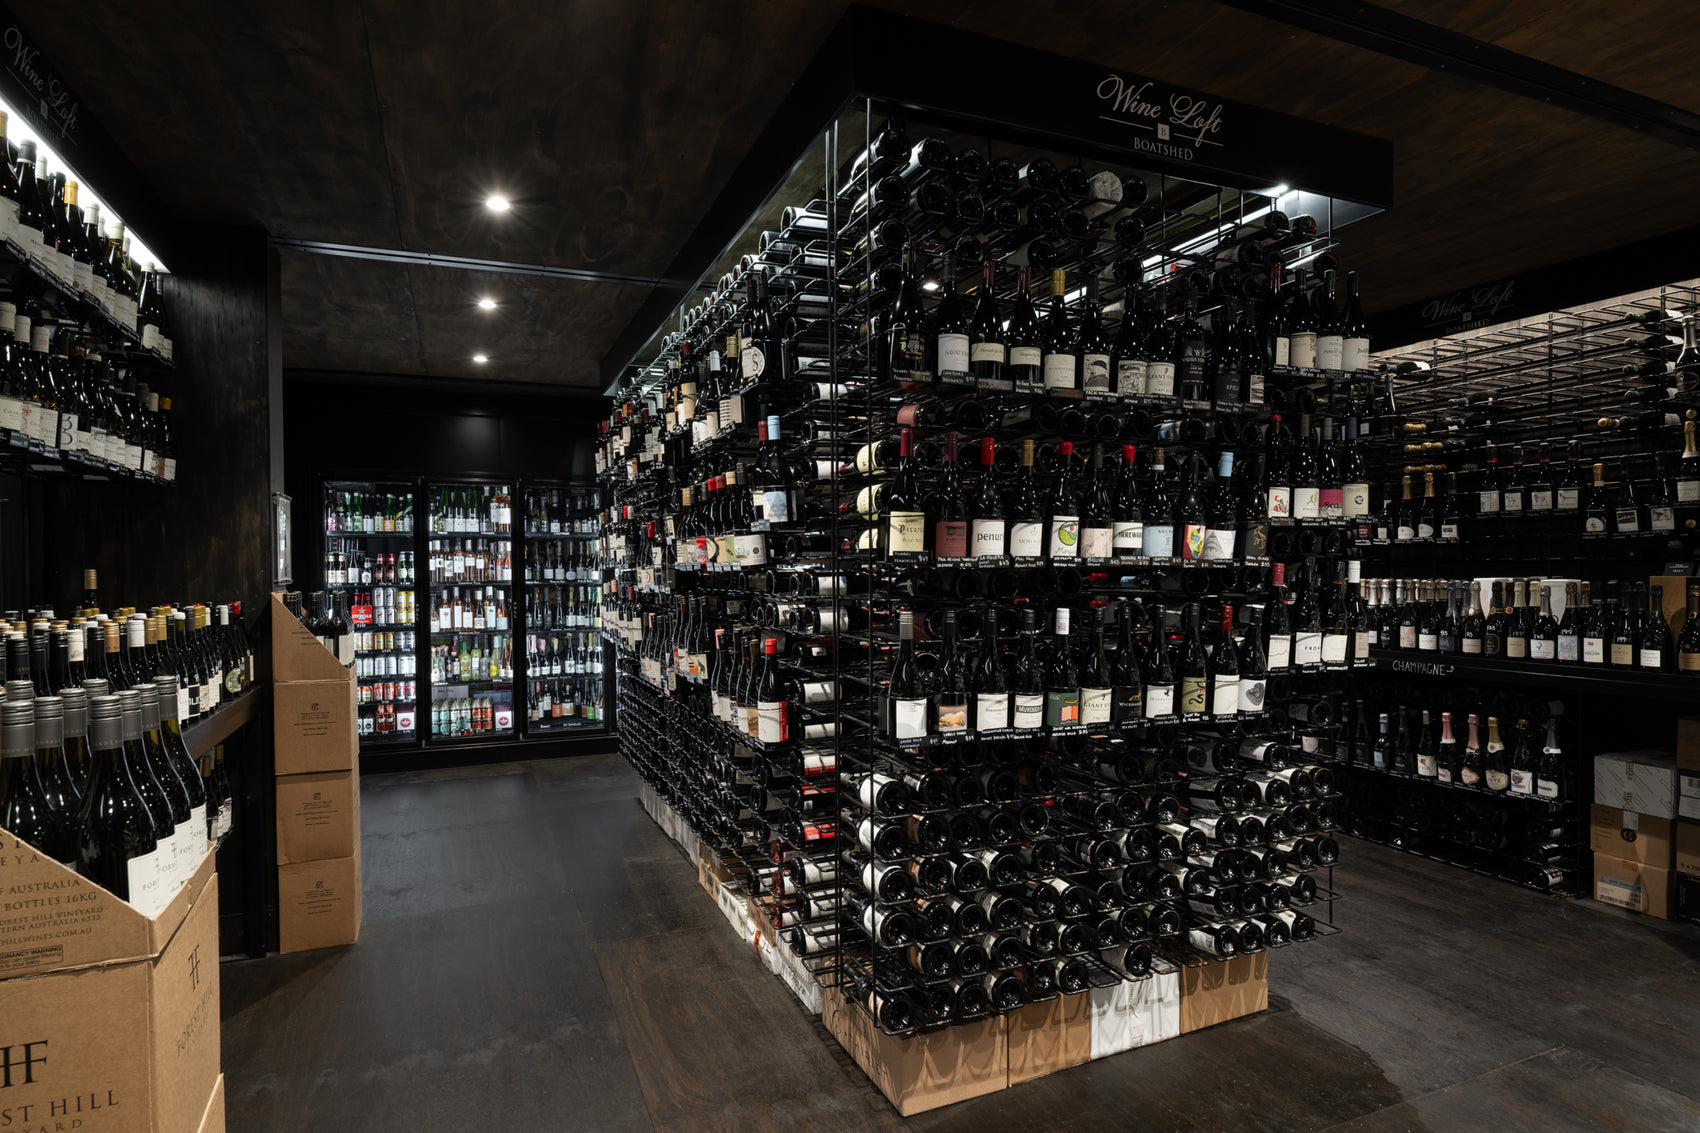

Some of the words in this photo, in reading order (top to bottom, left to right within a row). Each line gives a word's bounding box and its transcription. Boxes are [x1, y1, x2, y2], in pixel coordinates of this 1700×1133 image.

[4, 24, 44, 91] Wine
[48, 72, 78, 138] Loft
[1097, 74, 1160, 118] Wine
[1169, 93, 1223, 147] Loft
[1134, 137, 1193, 160] BOATSHED
[1422, 292, 1466, 320] Wine
[1471, 280, 1514, 316] Loft
[1392, 660, 1446, 676] CHAMPAGNE
[9, 879, 80, 894] AUSTRALIA
[5, 897, 60, 912] BOTTLES
[67, 892, 97, 904] 16KG
[29, 918, 78, 930] AUSTRALIA
[32, 913, 53, 922] HILL
[56, 906, 104, 918] VINEYARD
[2, 1105, 34, 1126] ST
[50, 1090, 119, 1117] HILL
